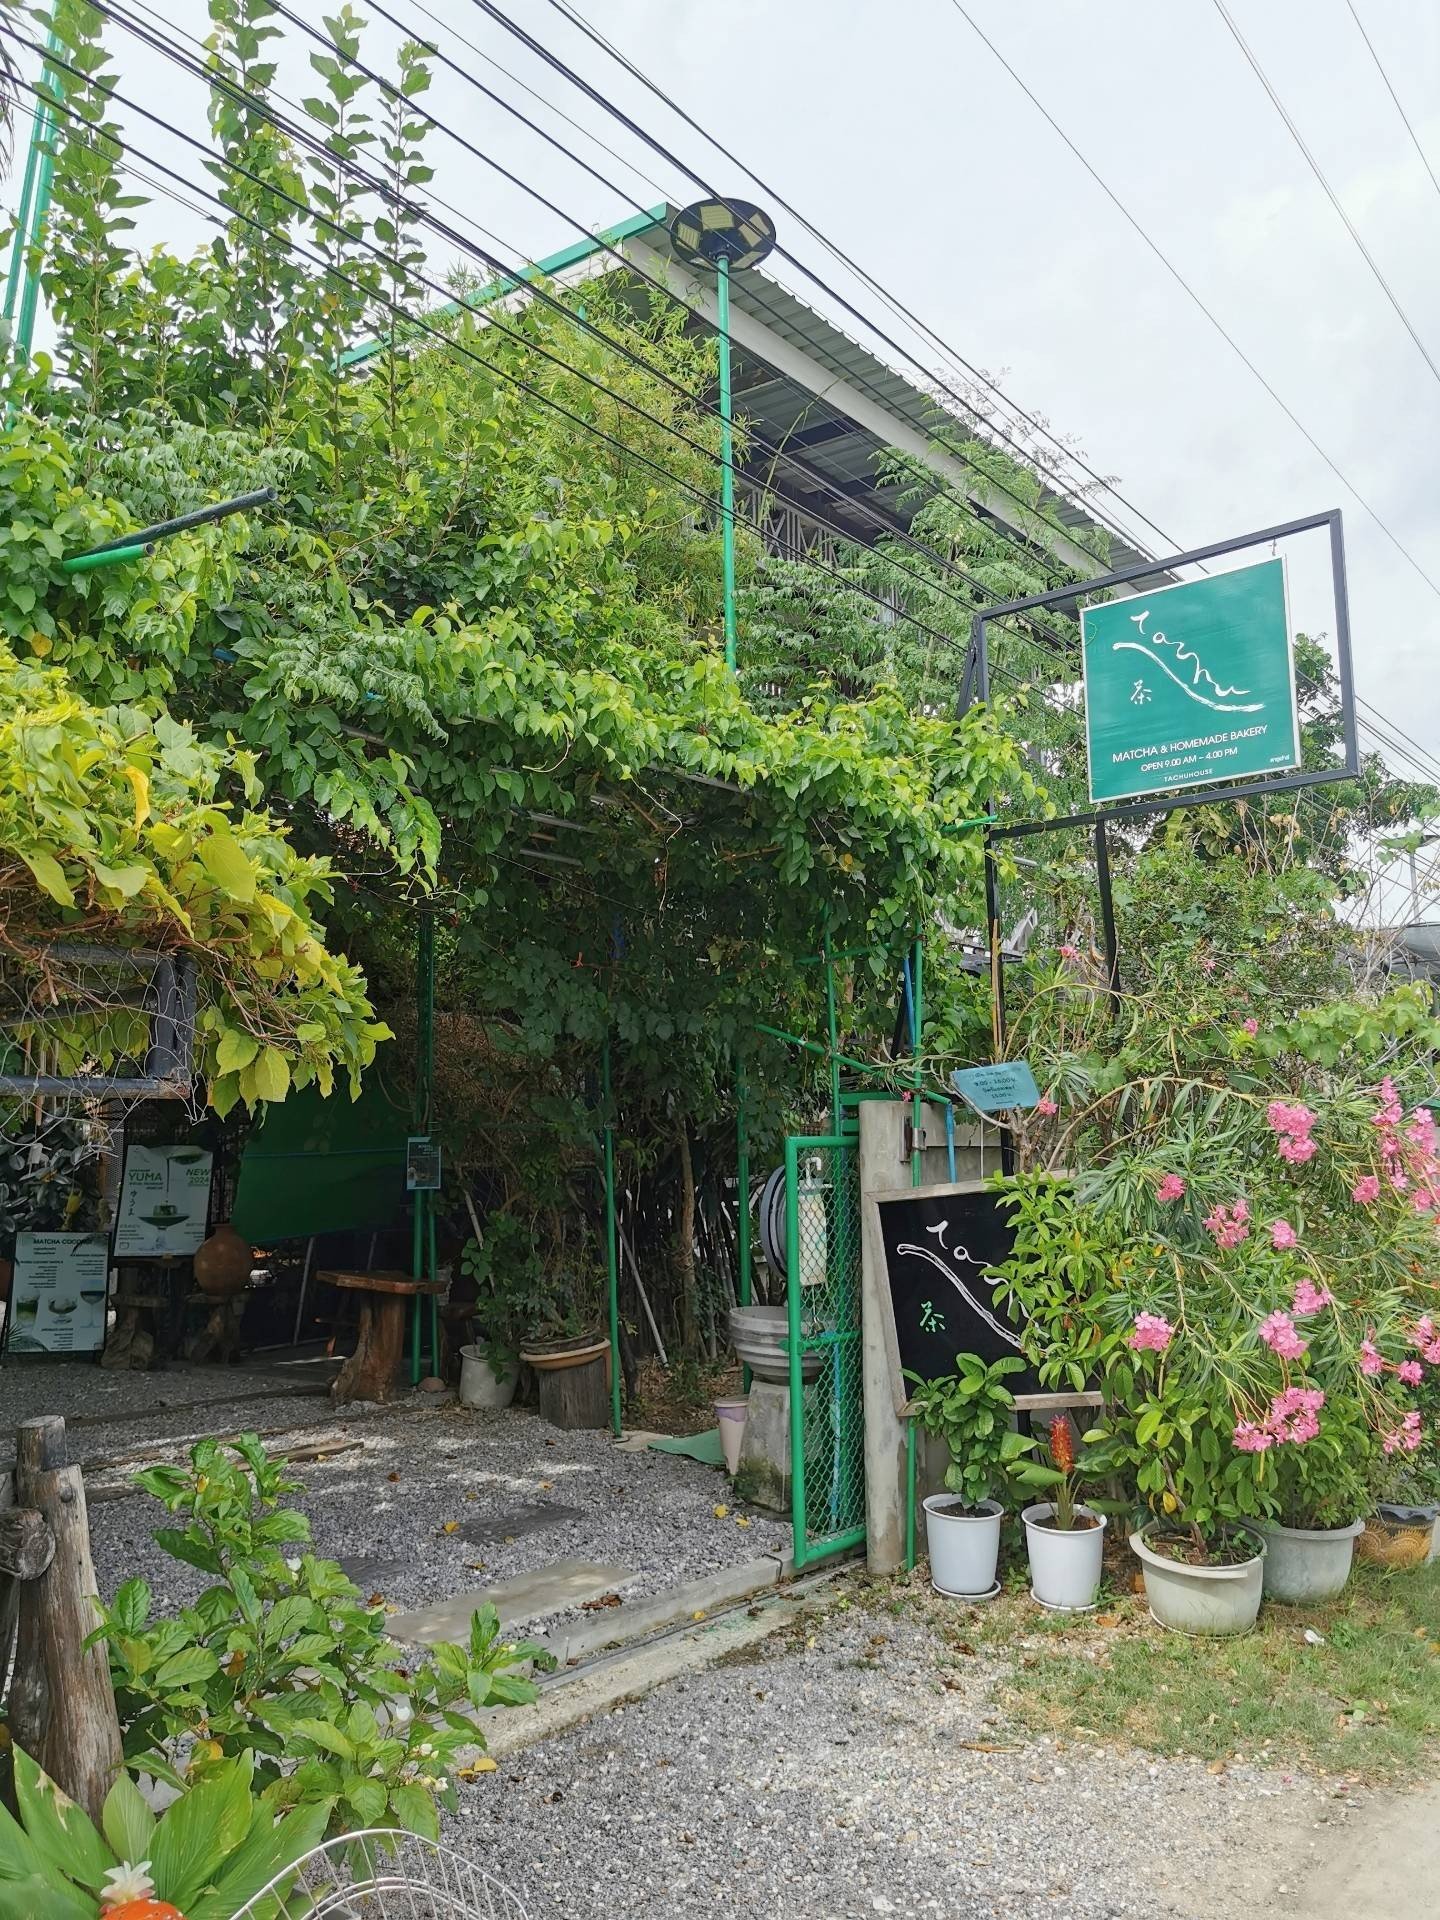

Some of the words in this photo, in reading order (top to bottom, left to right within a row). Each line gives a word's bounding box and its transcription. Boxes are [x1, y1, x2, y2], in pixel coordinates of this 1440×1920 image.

[1130, 680, 1152, 705] 茶
[1112, 746, 1158, 763] MATCHA
[1160, 745, 1168, 754] &
[1170, 732, 1228, 752] HOMEMADE
[1231, 724, 1268, 741] BAKERY
[1140, 760, 1163, 773] OPEN
[1164, 757, 1181, 768] 9.00
[1183, 754, 1197, 765] AM
[1205, 750, 1223, 761] 4.00
[1224, 747, 1238, 757] PM
[1164, 768, 1213, 783] TACHUHOUSE
[128, 1172, 162, 1181] YUMA
[185, 1168, 210, 1176] NEW
[919, 1300, 946, 1333] 茶
